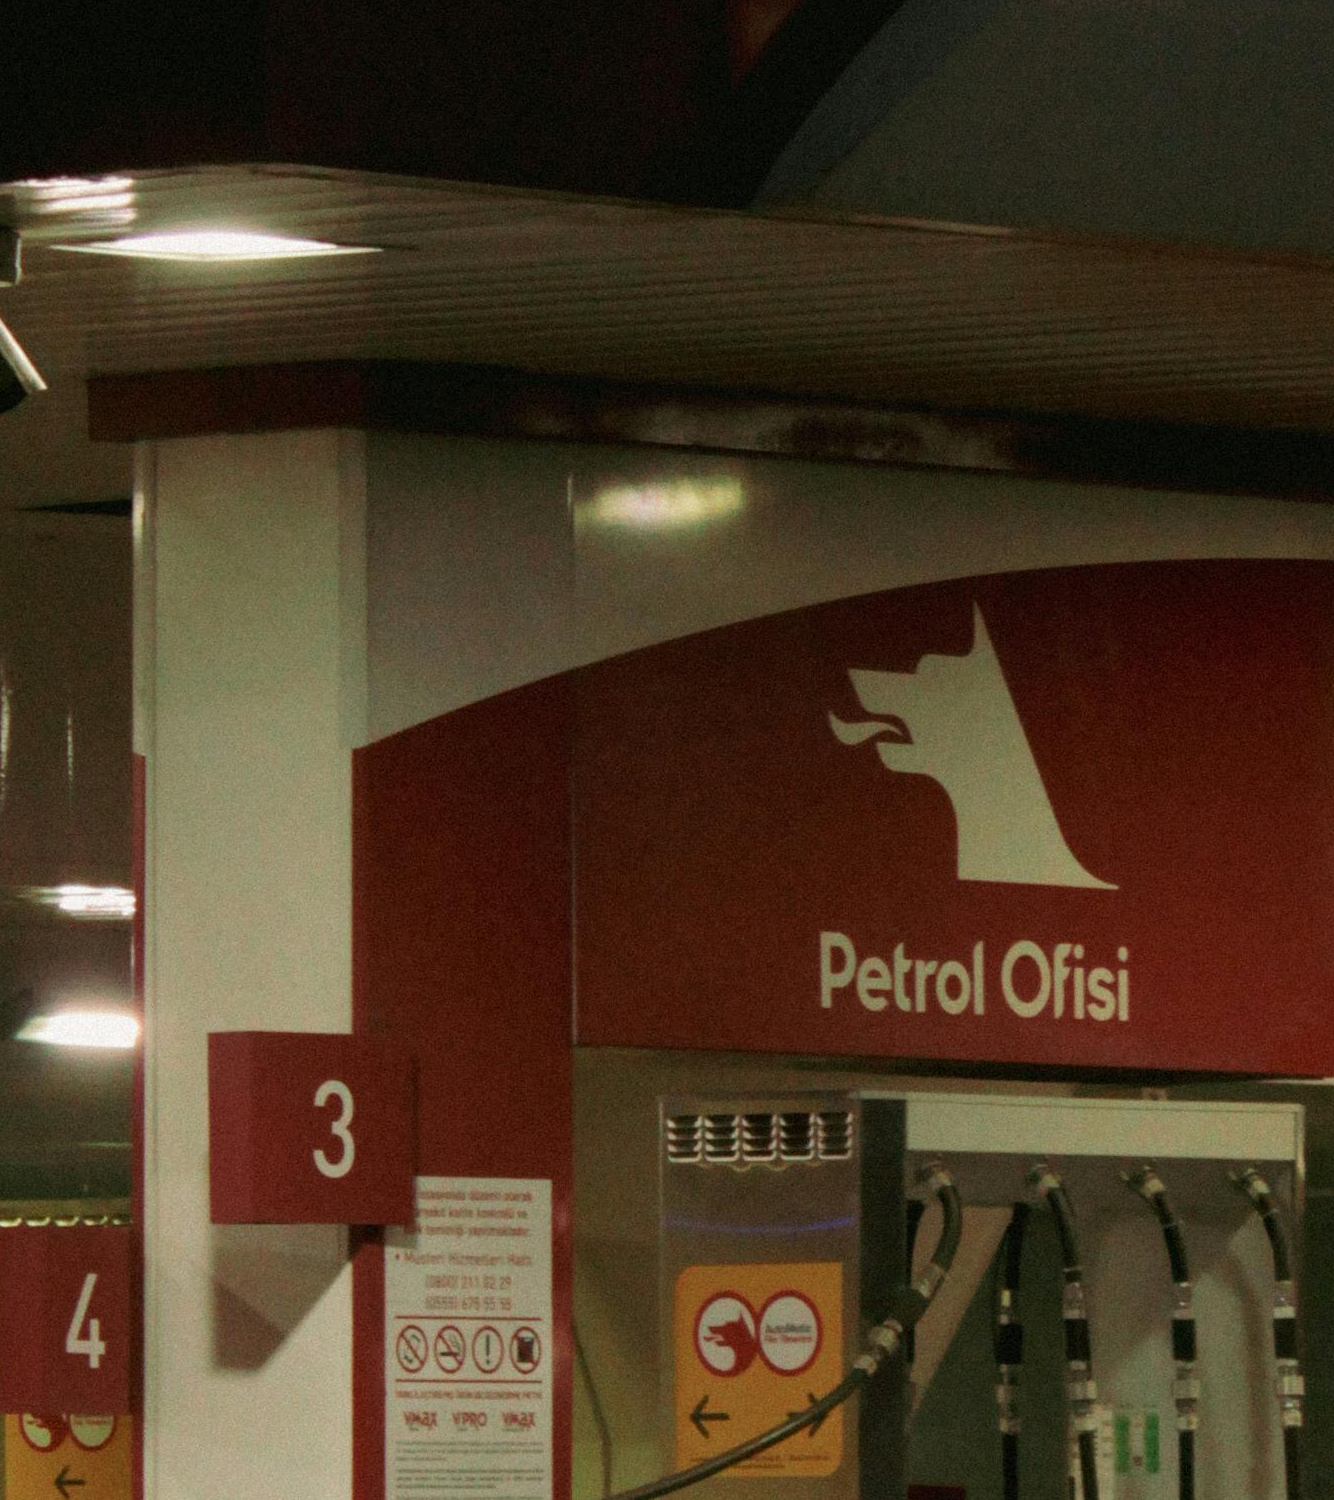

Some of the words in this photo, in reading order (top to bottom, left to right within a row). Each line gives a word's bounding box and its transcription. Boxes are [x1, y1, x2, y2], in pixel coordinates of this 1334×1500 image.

[818, 930, 986, 1015] Petrol
[1000, 939, 1130, 1022] Ofisi
[312, 1078, 356, 1179] 3
[64, 1272, 106, 1370] 4
